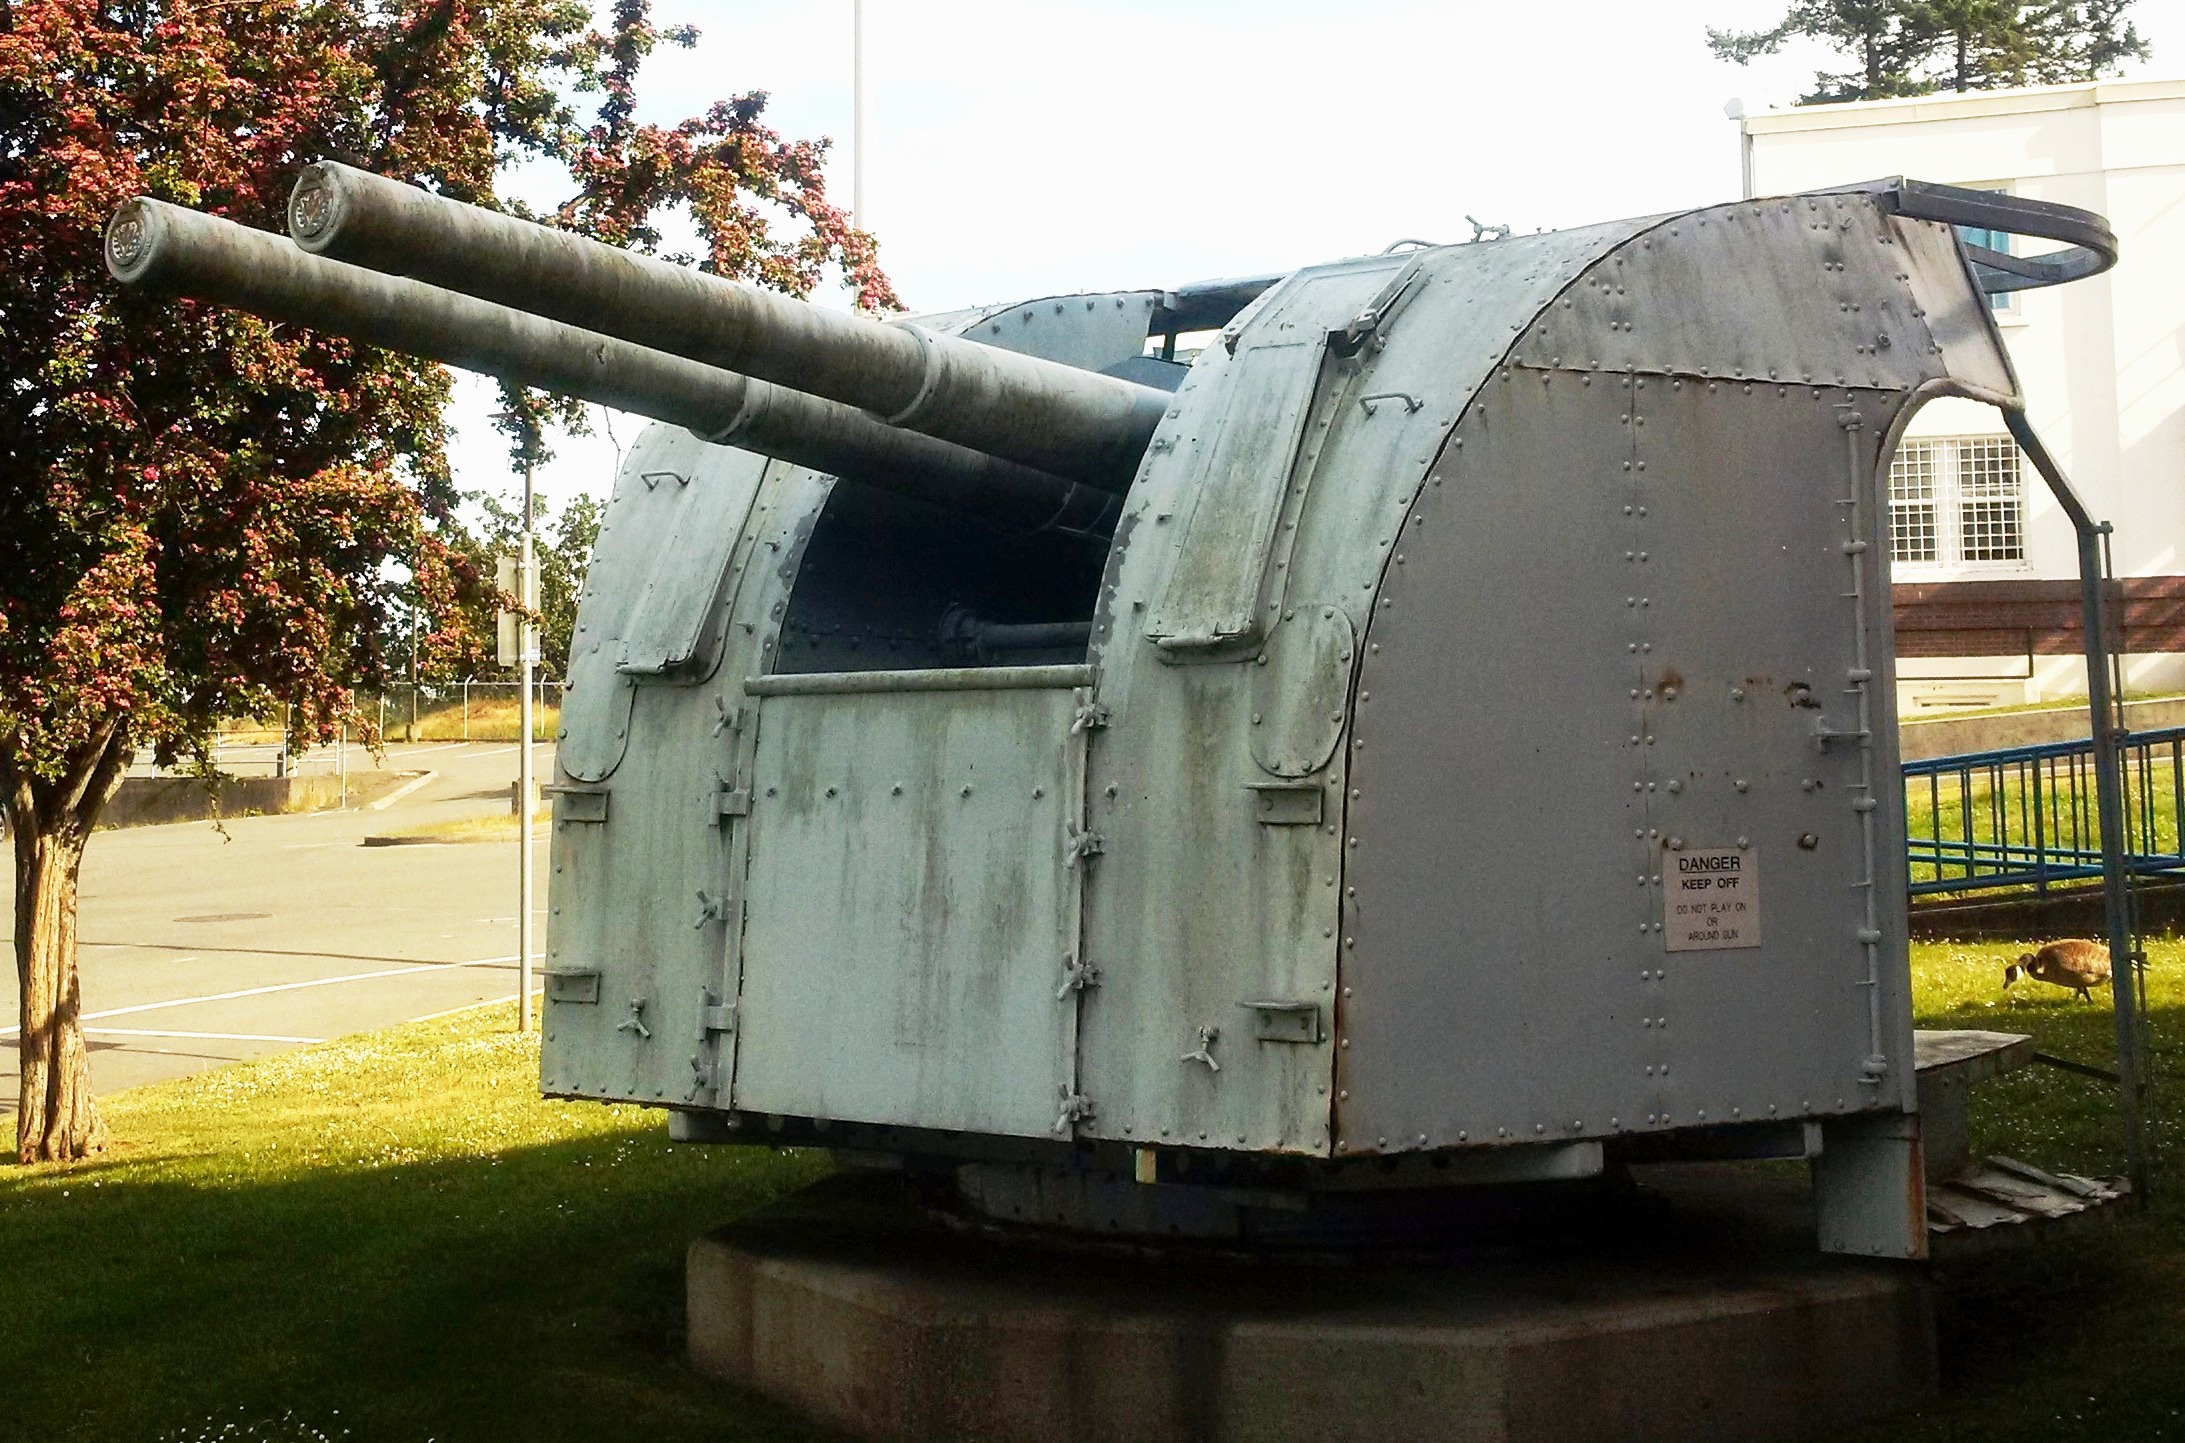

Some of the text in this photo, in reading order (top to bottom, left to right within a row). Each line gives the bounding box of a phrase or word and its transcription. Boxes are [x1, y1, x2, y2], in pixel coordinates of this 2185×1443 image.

[1679, 856, 1741, 870] DANGER
[1681, 877, 1740, 889] KEEP OFF
[1676, 902, 1747, 915] DO NOT PLAY ON
[1706, 917, 1718, 927] OR
[1688, 929, 1738, 941] AROUND GUN
